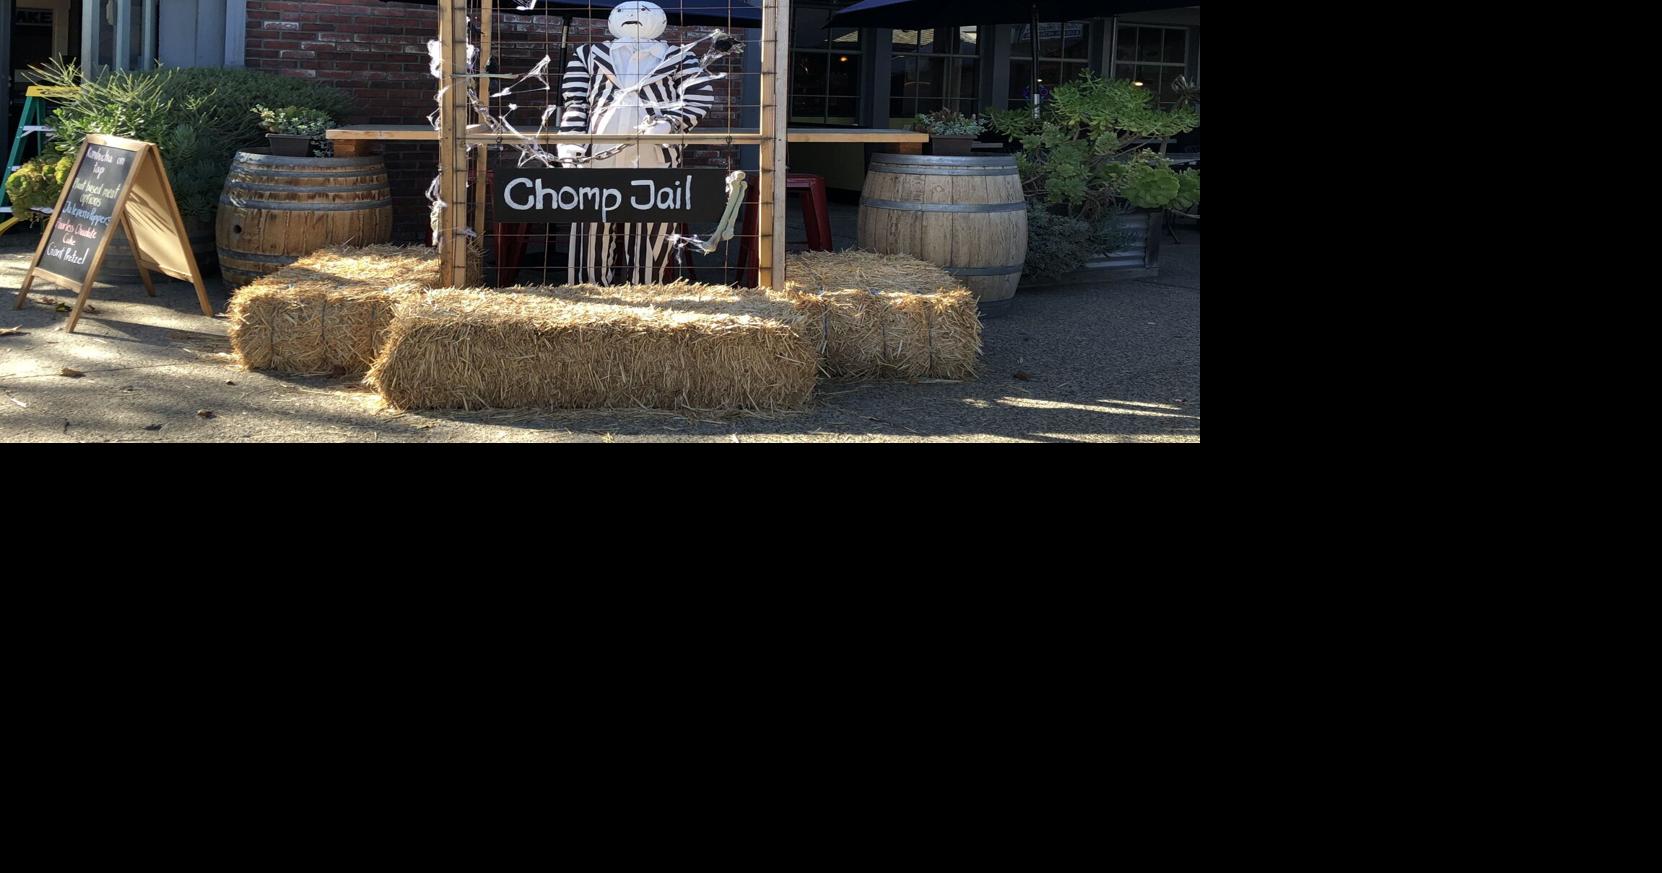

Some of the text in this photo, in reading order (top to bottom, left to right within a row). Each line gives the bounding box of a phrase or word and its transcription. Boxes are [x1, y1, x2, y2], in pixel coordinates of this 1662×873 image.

[116, 157, 125, 165] on
[93, 161, 105, 179] tap
[85, 181, 104, 195] based
[102, 183, 121, 198] meat
[504, 175, 692, 223] Chomp Jail
[63, 232, 76, 245] Cake
[46, 241, 66, 259] Giant
